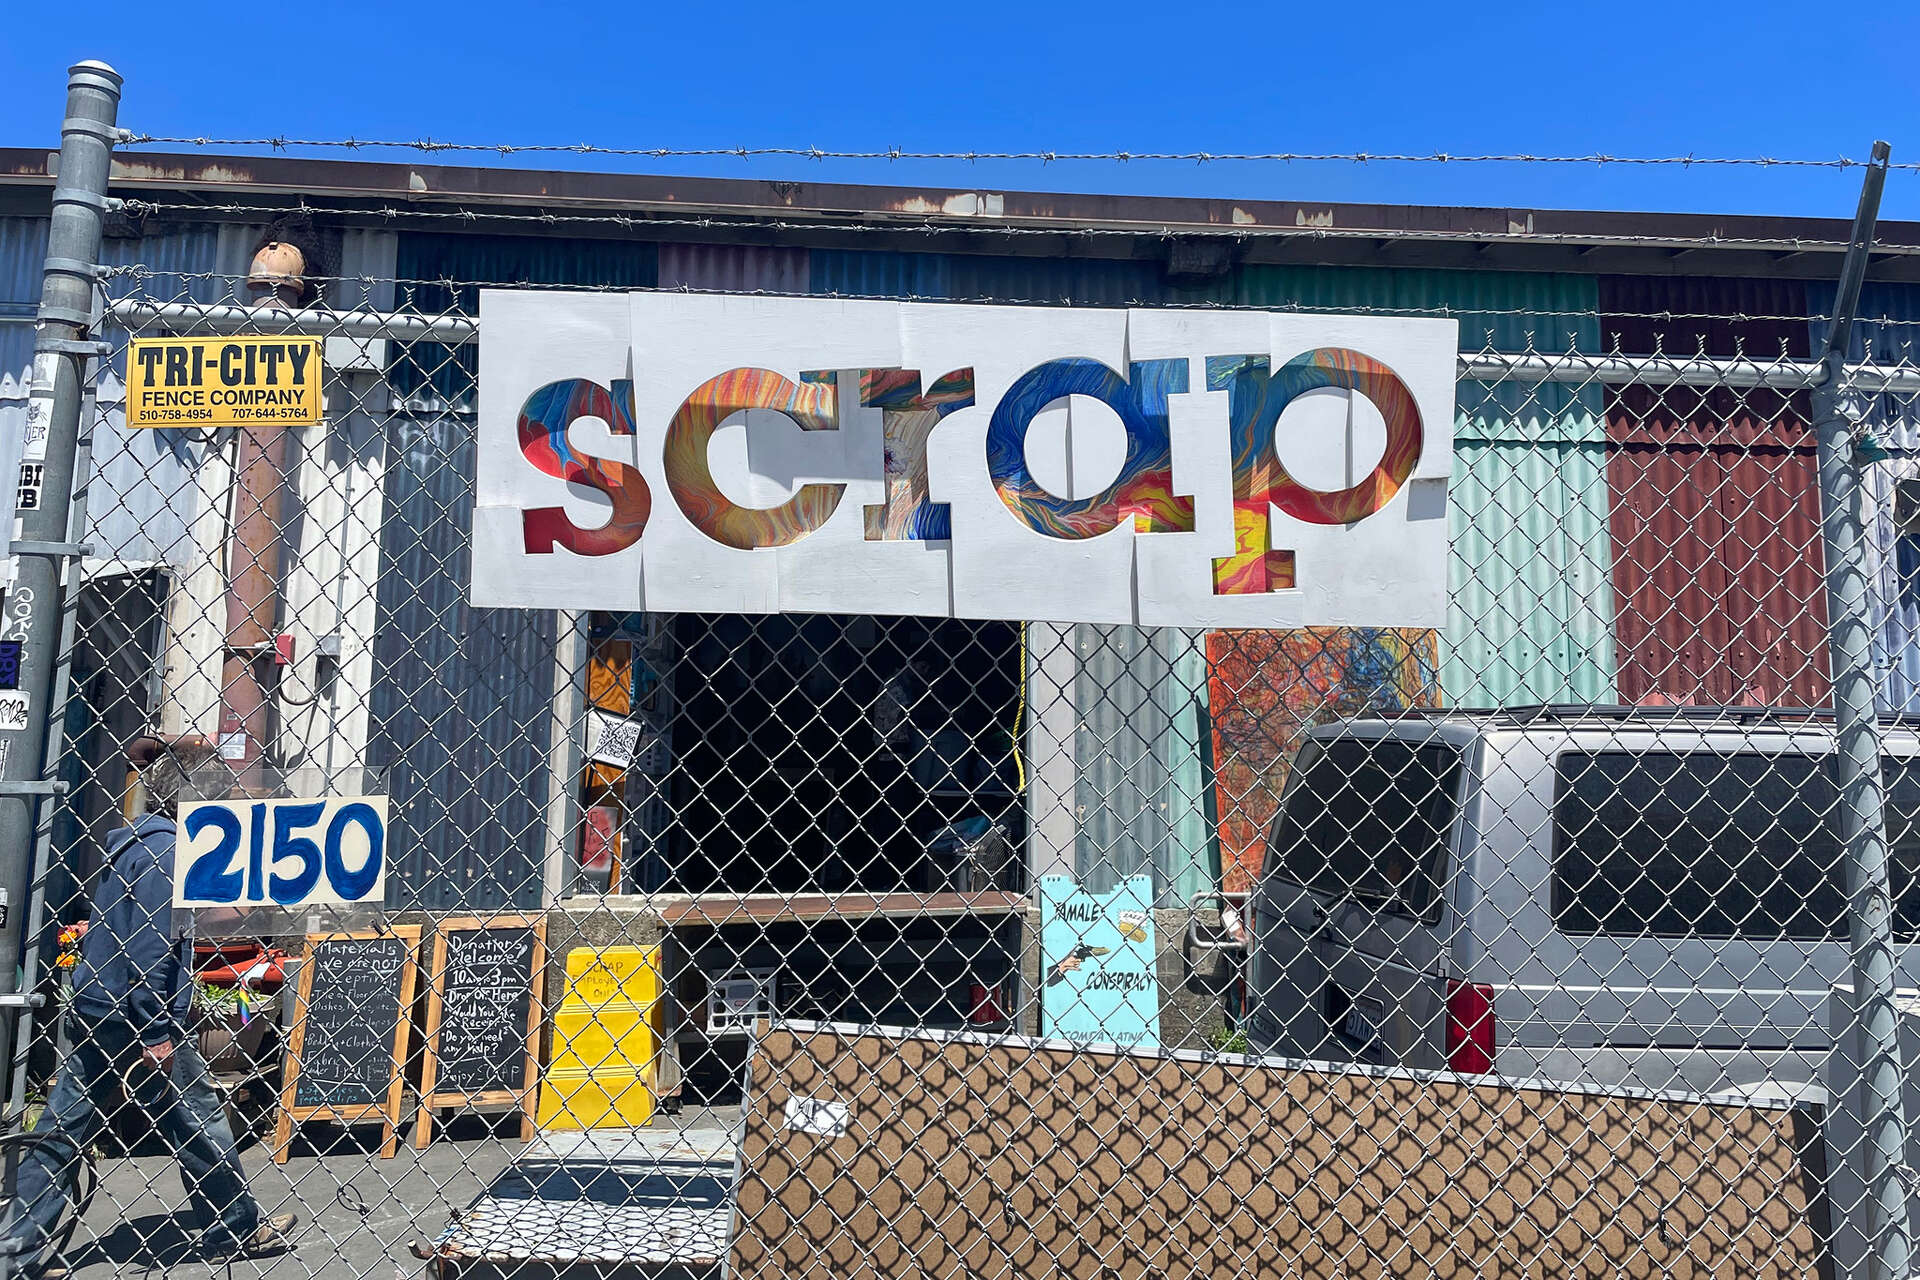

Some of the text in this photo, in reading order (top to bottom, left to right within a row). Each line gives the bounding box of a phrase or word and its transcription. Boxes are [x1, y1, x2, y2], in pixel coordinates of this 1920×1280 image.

[138, 344, 311, 387] TRI-CITY
[142, 389, 306, 407] FENCE COMPANY
[139, 408, 308, 421] 510-758-4954 707-644-5764
[517, 345, 1424, 596] scrap
[183, 800, 384, 905] 2150
[1054, 902, 1100, 922] TAMALE
[319, 940, 397, 956] Materials
[372, 957, 401, 970] not
[1085, 971, 1153, 992] CONSPIRACY
[446, 1030, 458, 1042] Do
[477, 1063, 520, 1083] SCAP
